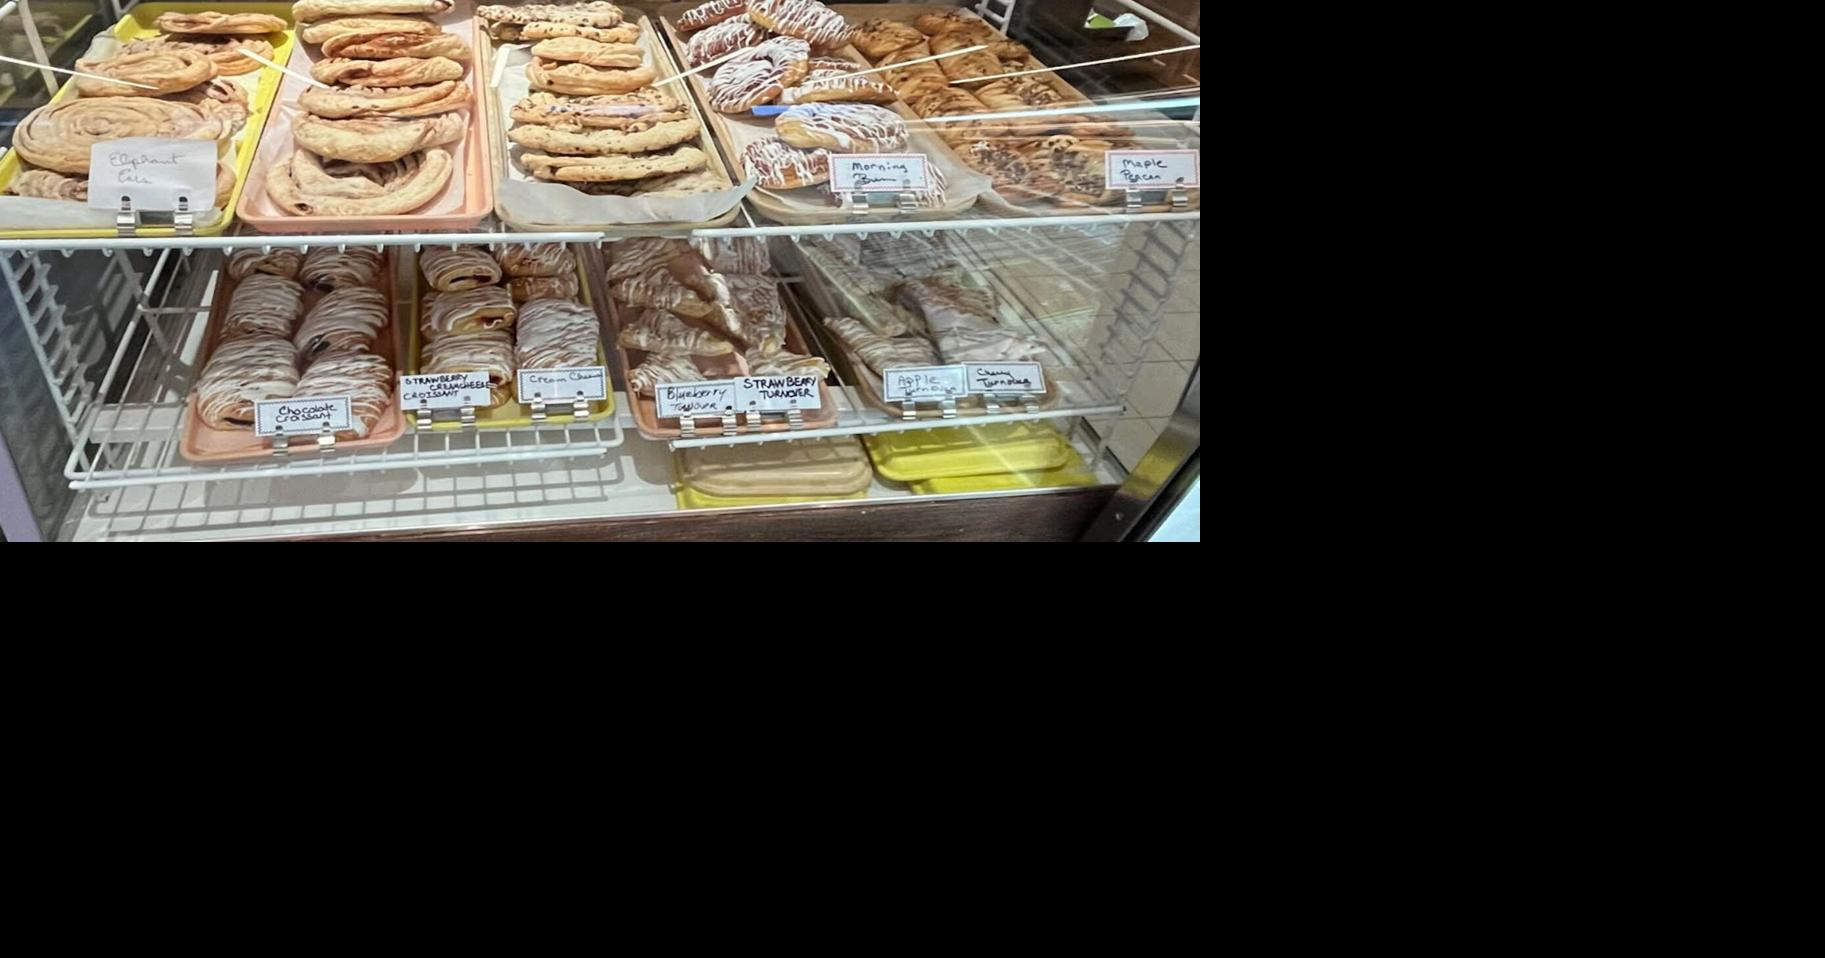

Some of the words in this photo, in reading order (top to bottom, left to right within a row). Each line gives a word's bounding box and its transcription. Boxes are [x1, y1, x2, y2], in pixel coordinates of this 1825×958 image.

[109, 152, 185, 169] Elephant
[1122, 158, 1168, 169] Maple
[852, 161, 908, 173] Morning
[405, 374, 468, 385] STRAWBERRY
[529, 375, 567, 384] Cream
[403, 390, 459, 400] CROISSANT
[667, 386, 727, 401] Blueberry
[759, 388, 815, 400] TURNOVER
[278, 403, 338, 416] Chocolate
